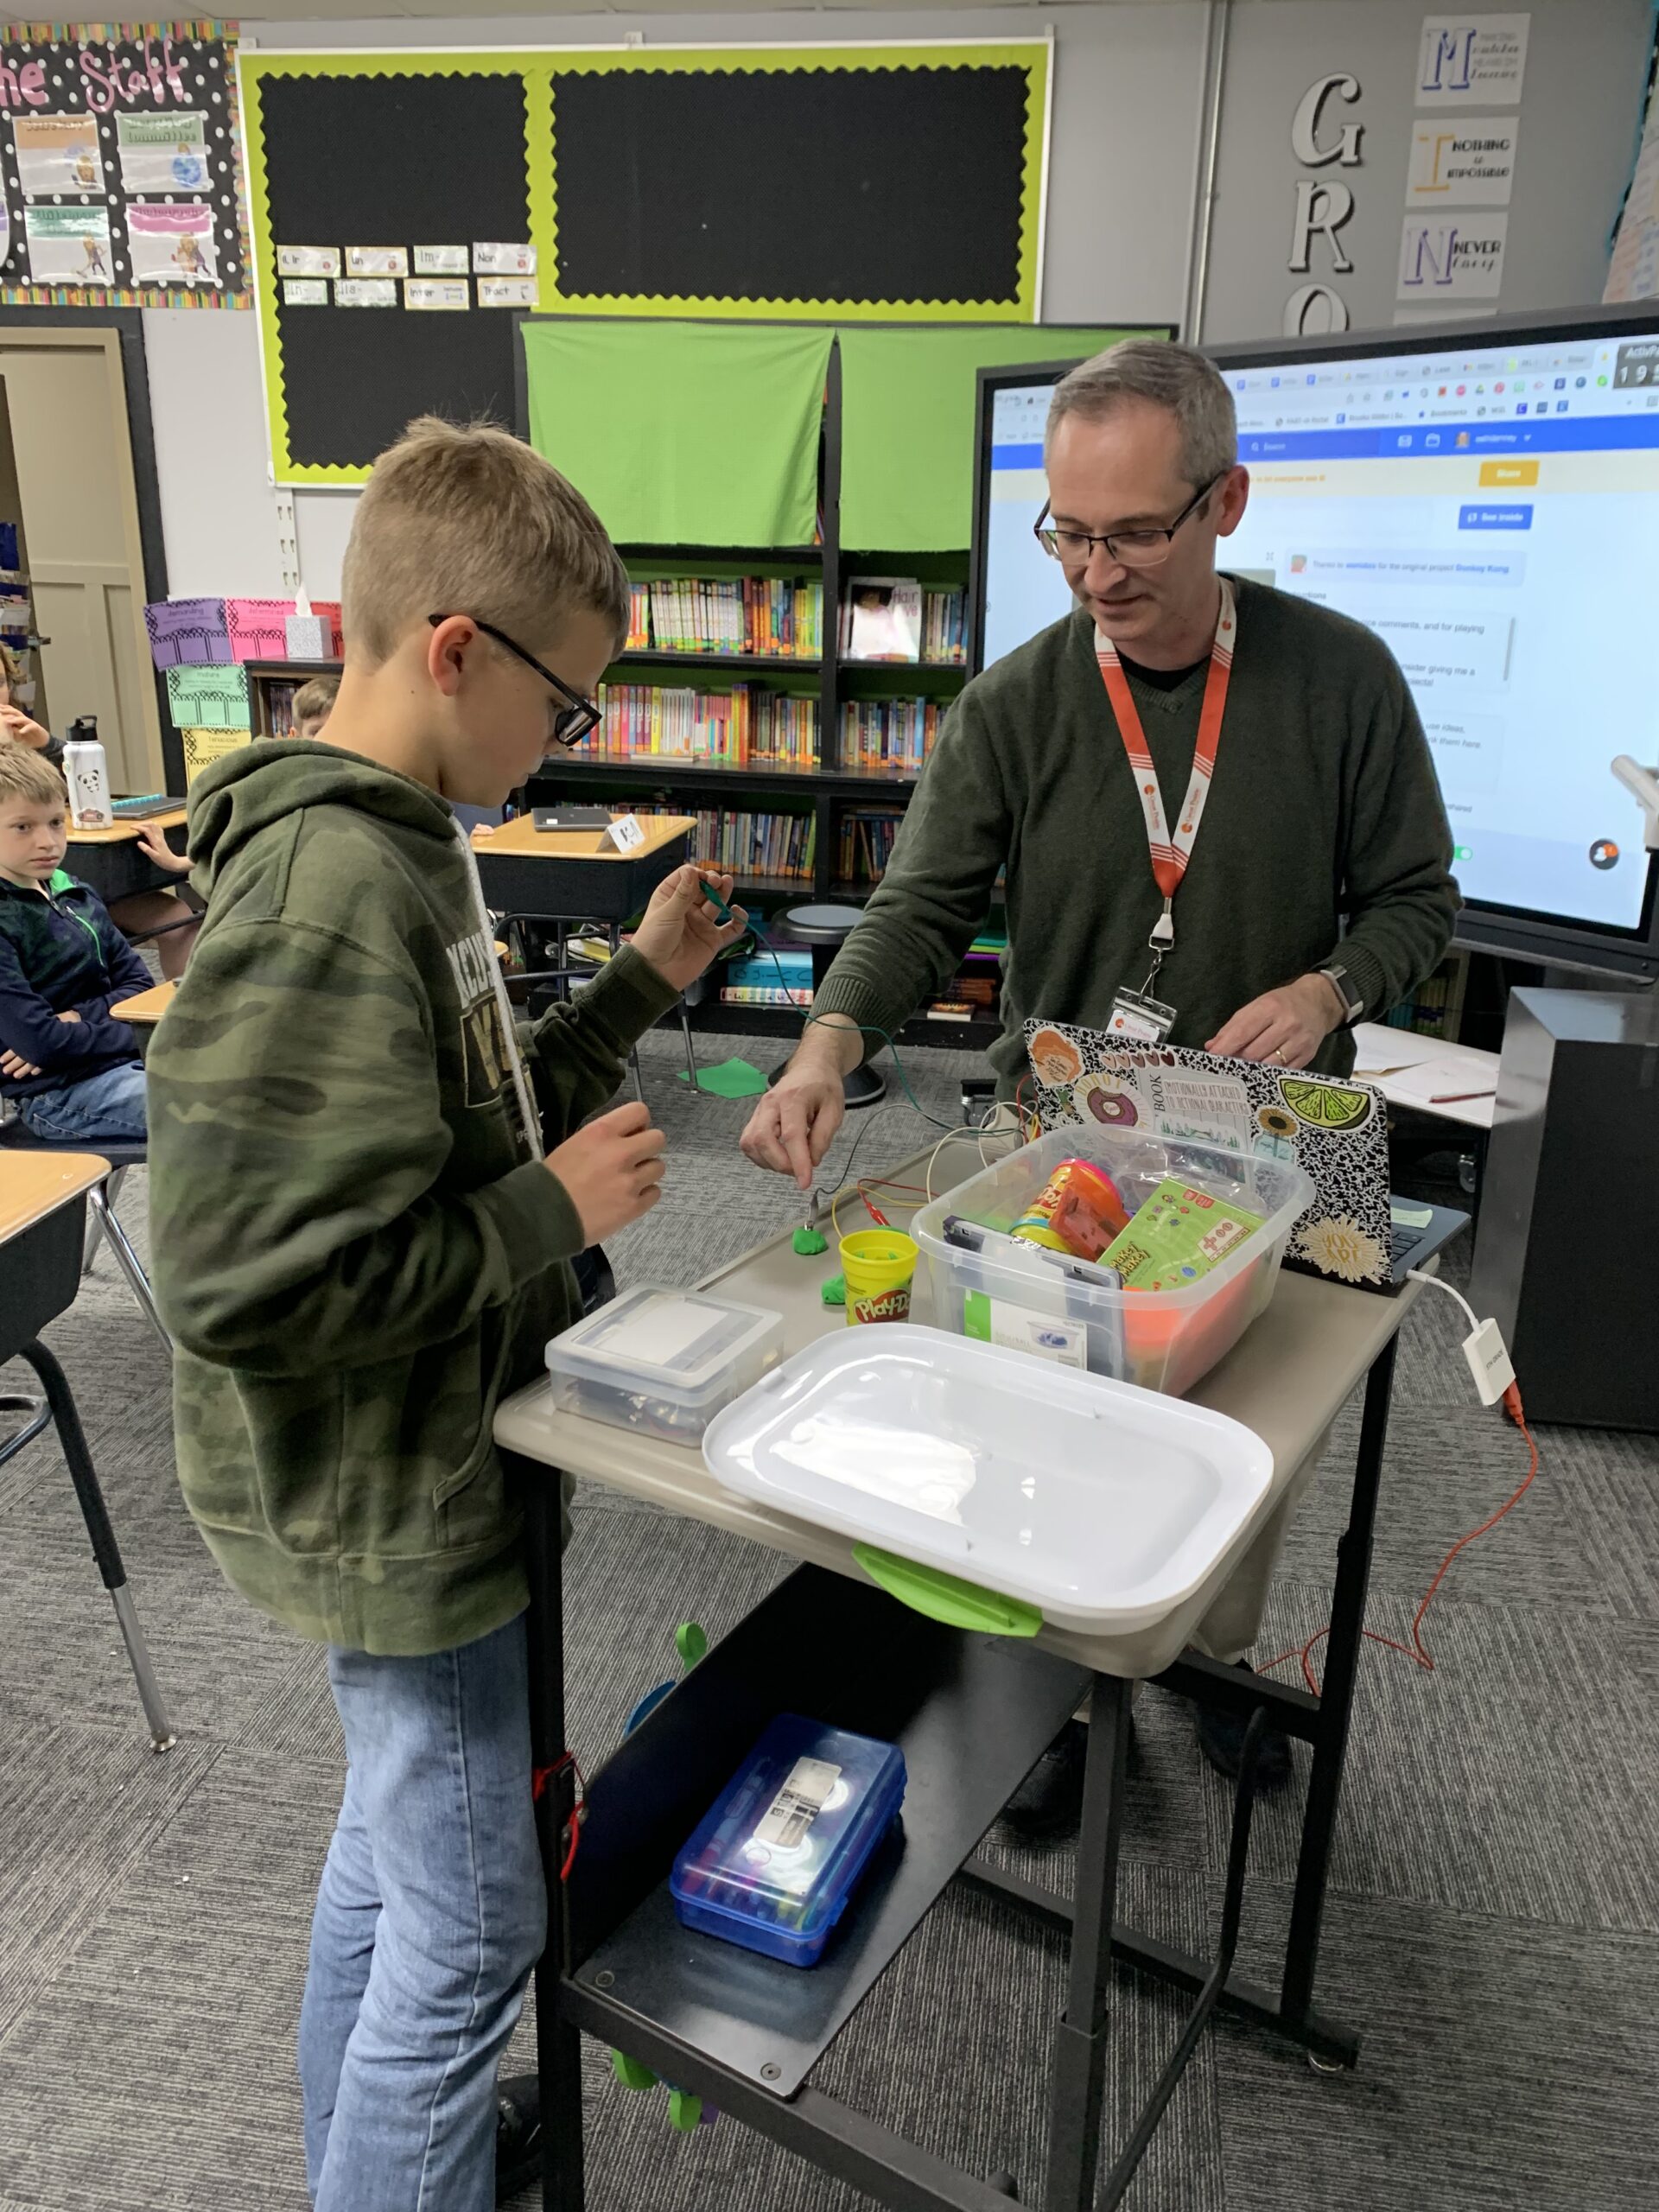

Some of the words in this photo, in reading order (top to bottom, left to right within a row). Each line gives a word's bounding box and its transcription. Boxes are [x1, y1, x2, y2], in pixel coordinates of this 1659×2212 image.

[1421, 27, 1477, 91] M
[79, 33, 188, 113] Staff
[1452, 138, 1510, 152] NOTHING
[1446, 167, 1510, 179] IMPOSSIBLE
[1453, 240, 1502, 254] NEVER
[477, 252, 497, 264] Non
[484, 285, 510, 296] Tract
[1455, 563, 1484, 574] Donkey
[893, 588, 918, 603] Hair
[1423, 621, 1440, 631] and
[1441, 622, 1452, 631] for
[1454, 623, 1485, 635] playing
[1427, 664, 1452, 676] giving
[1454, 667, 1468, 676] me
[1149, 1074, 1166, 1112] BOOK
